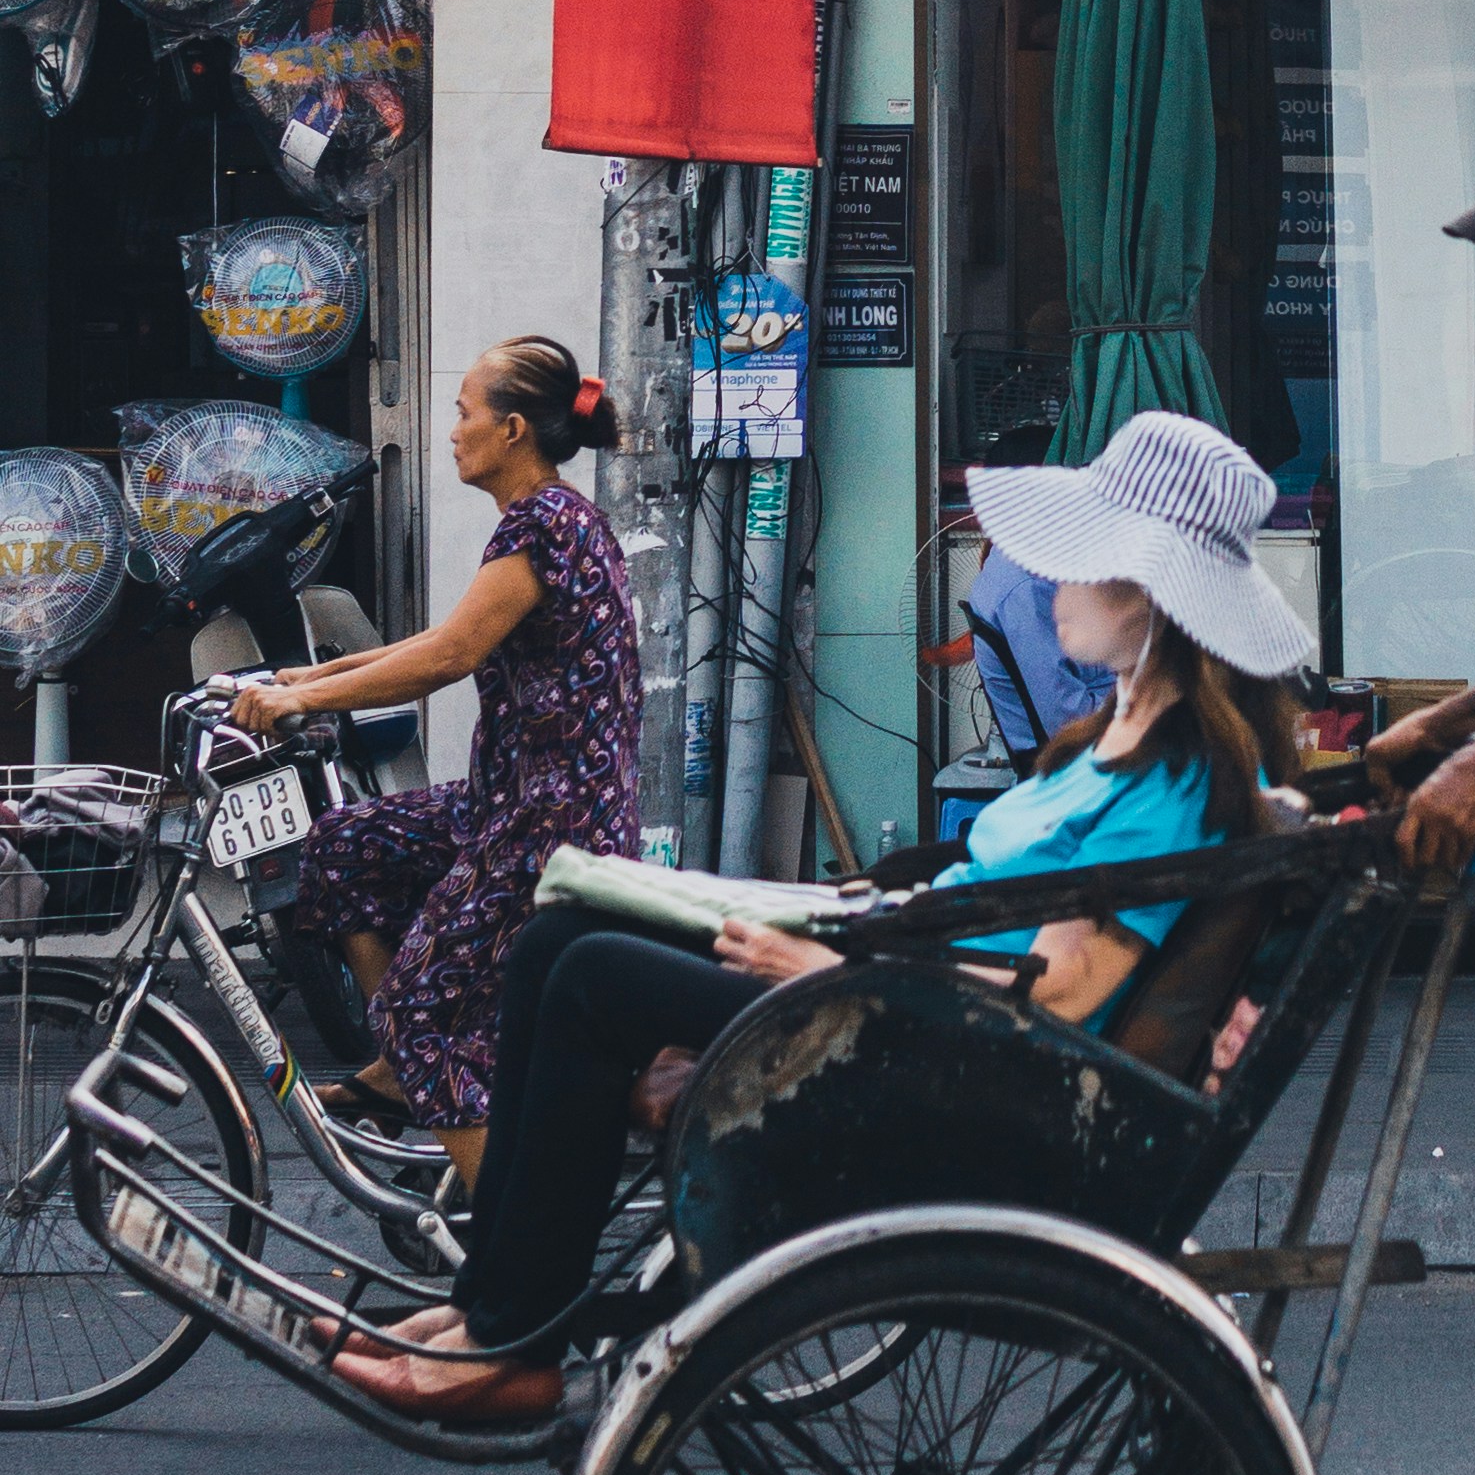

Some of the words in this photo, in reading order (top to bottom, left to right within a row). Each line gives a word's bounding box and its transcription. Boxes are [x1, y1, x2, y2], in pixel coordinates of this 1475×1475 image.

[239, 38, 423, 88] SENKO
[833, 172, 860, 196] IỆT
[864, 177, 902, 194] NAM
[200, 305, 346, 336] SENKO
[852, 305, 898, 326] LONG
[710, 372, 778, 387] vnaphone
[222, 808, 297, 856] 6109
